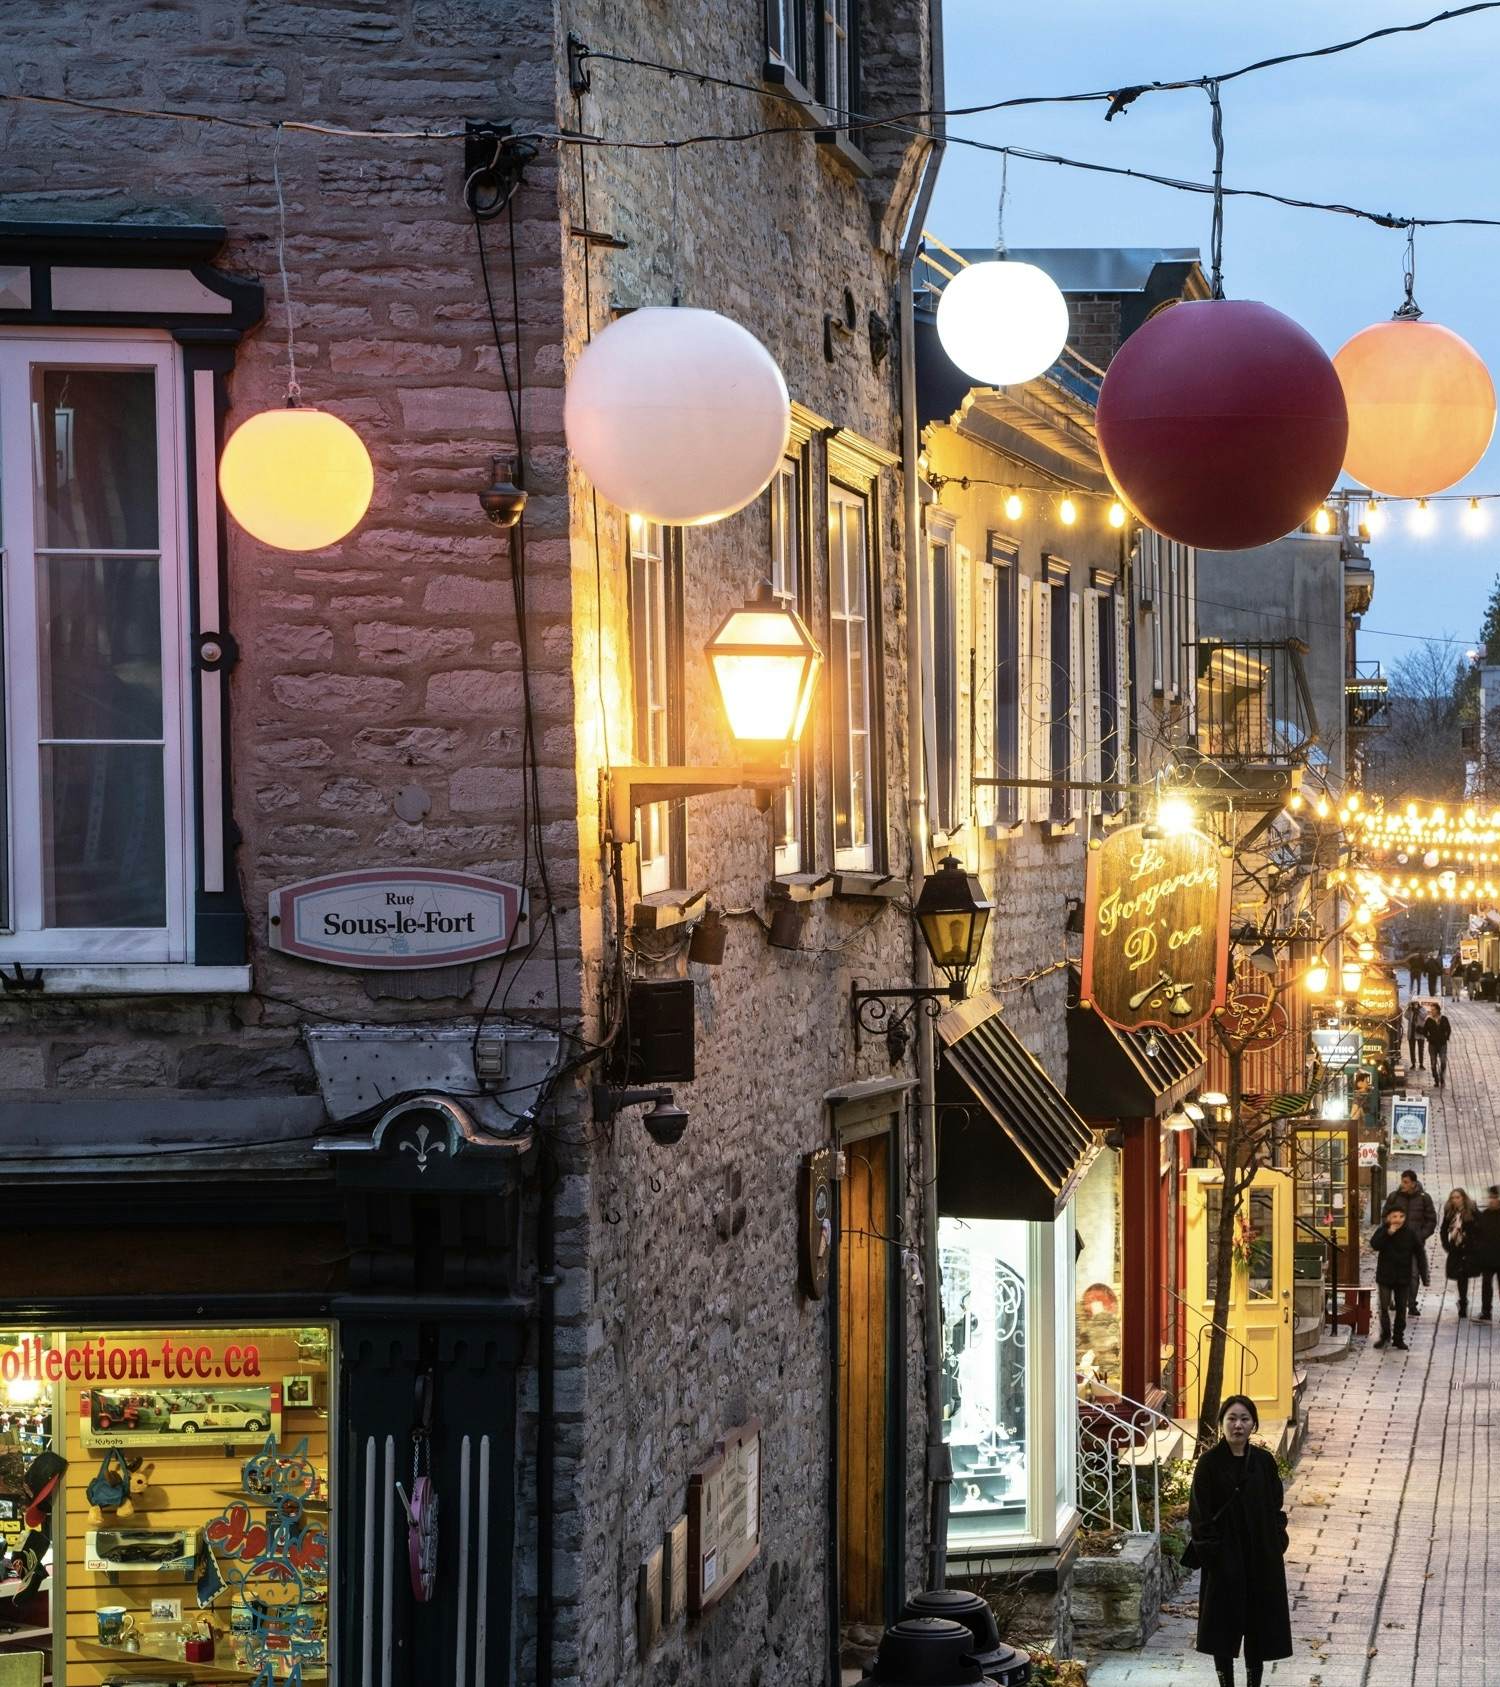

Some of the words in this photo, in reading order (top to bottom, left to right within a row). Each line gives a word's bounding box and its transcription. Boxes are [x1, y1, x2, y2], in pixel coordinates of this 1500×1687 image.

[1130, 848, 1165, 880] Le
[385, 892, 414, 905] Rue
[1099, 867, 1218, 936] Forgeron
[323, 911, 476, 936] Sous-le-Fort
